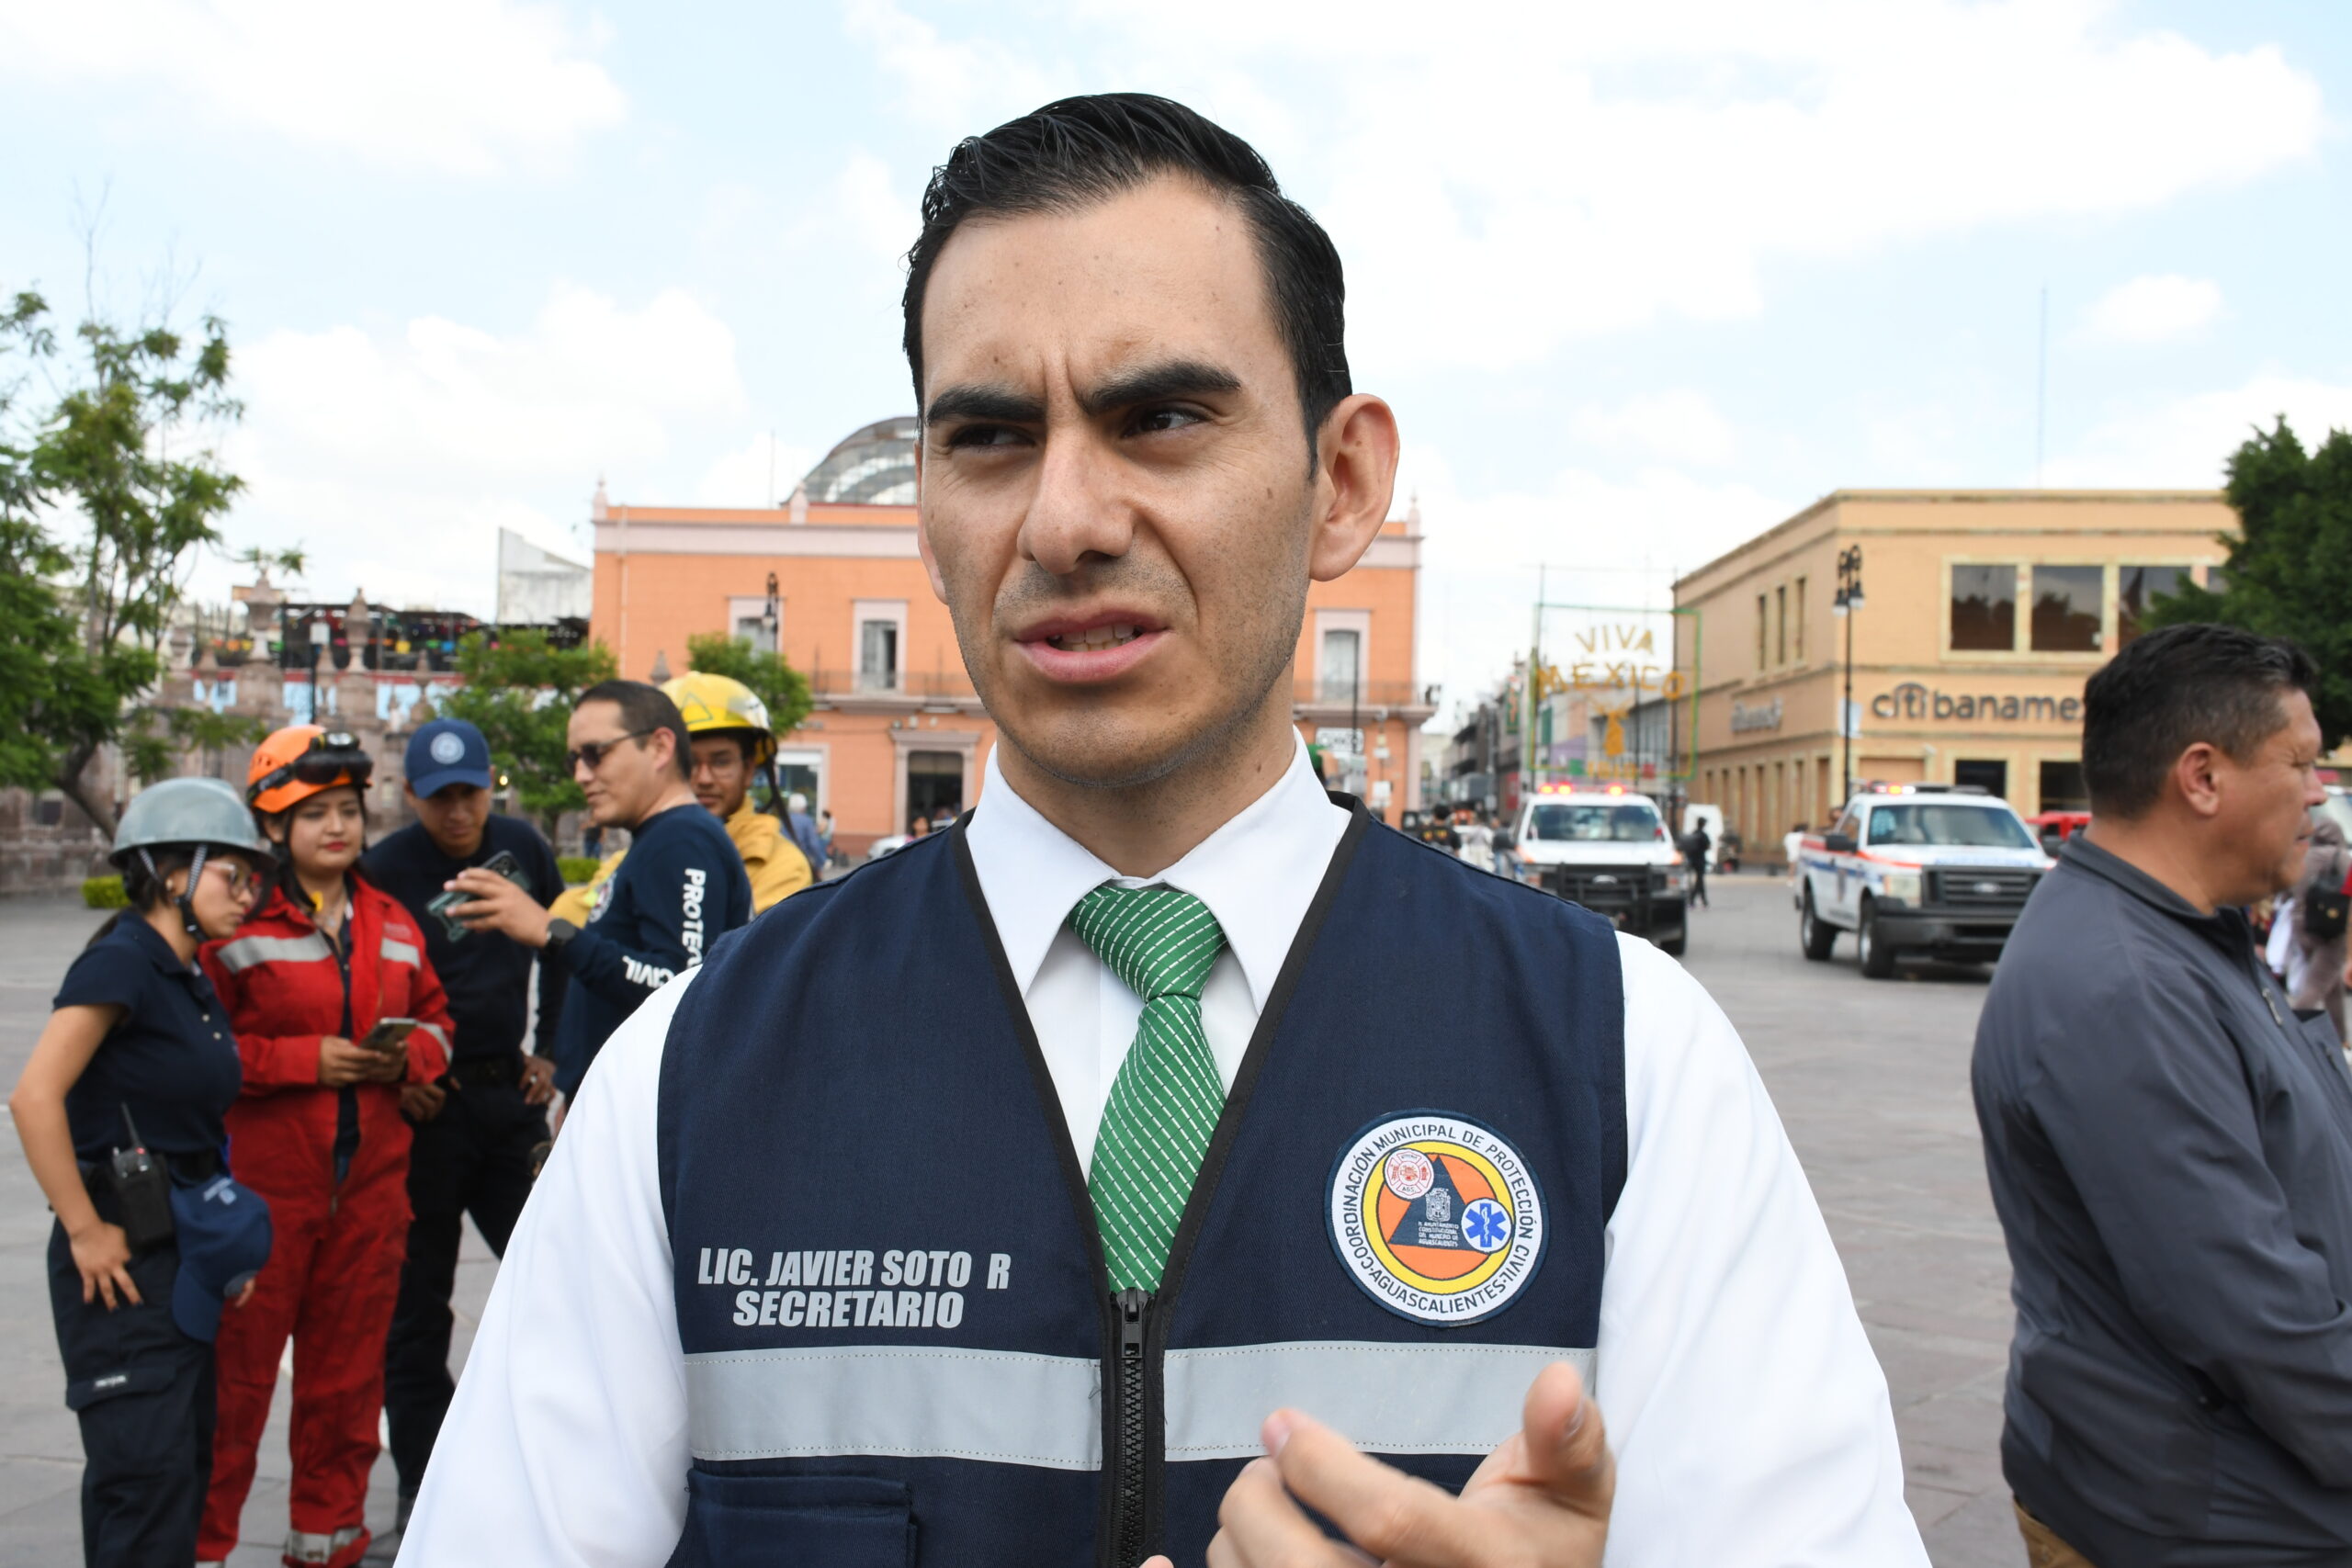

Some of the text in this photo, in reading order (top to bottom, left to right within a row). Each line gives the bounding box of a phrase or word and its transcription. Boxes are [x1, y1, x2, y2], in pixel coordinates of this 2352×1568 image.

[1575, 625, 1654, 655] VIVA
[1871, 682, 2085, 722] citibaname
[683, 868, 706, 967] PROTEC
[1342, 1124, 1537, 1283] COORDINACIÓN MUNICIPAL DE PROTECCIÓN CIVIL
[698, 1247, 1012, 1290] LIC. JAVIER SOTO R
[732, 1290, 965, 1329] SECRETARIO
[1368, 1269, 1507, 1314] AGUASCALIENTES
